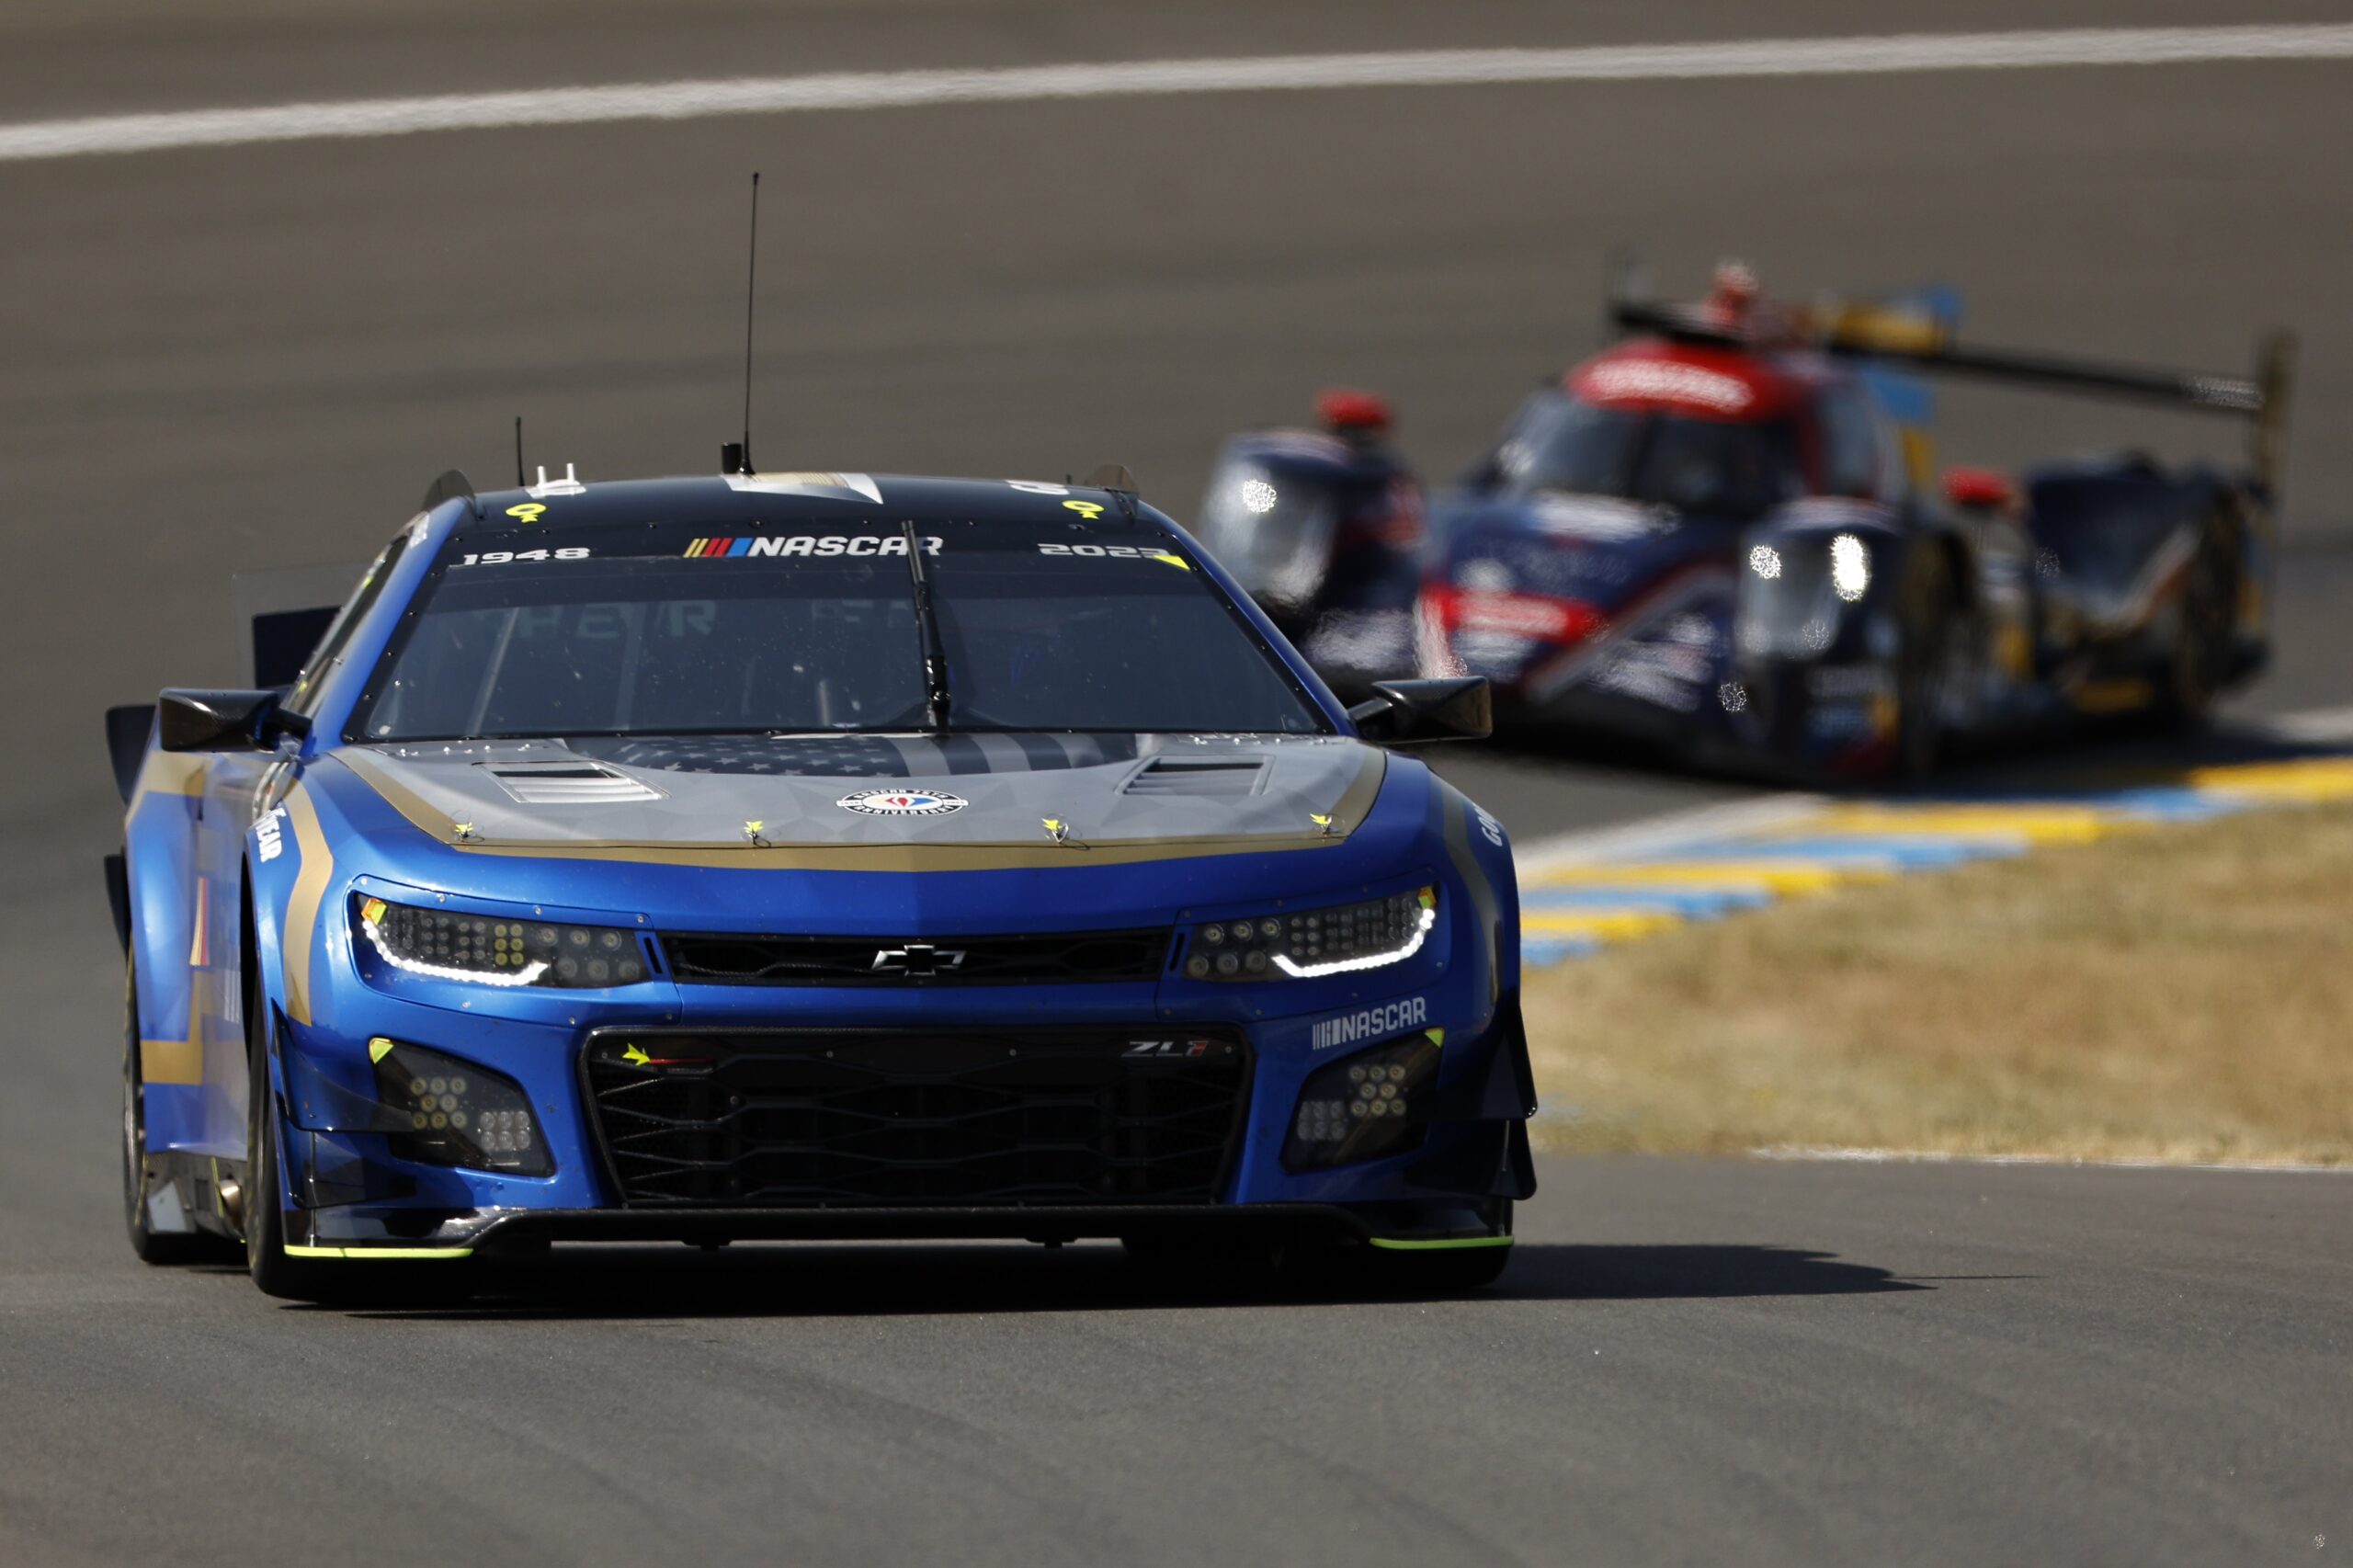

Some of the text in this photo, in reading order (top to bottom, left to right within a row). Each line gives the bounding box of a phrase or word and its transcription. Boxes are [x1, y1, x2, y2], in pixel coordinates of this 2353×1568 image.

[462, 547, 590, 565] 1948
[747, 536, 943, 557] NASCAR
[1341, 996, 1427, 1043] NASCAR
[1120, 1040, 1209, 1058] ZL1
